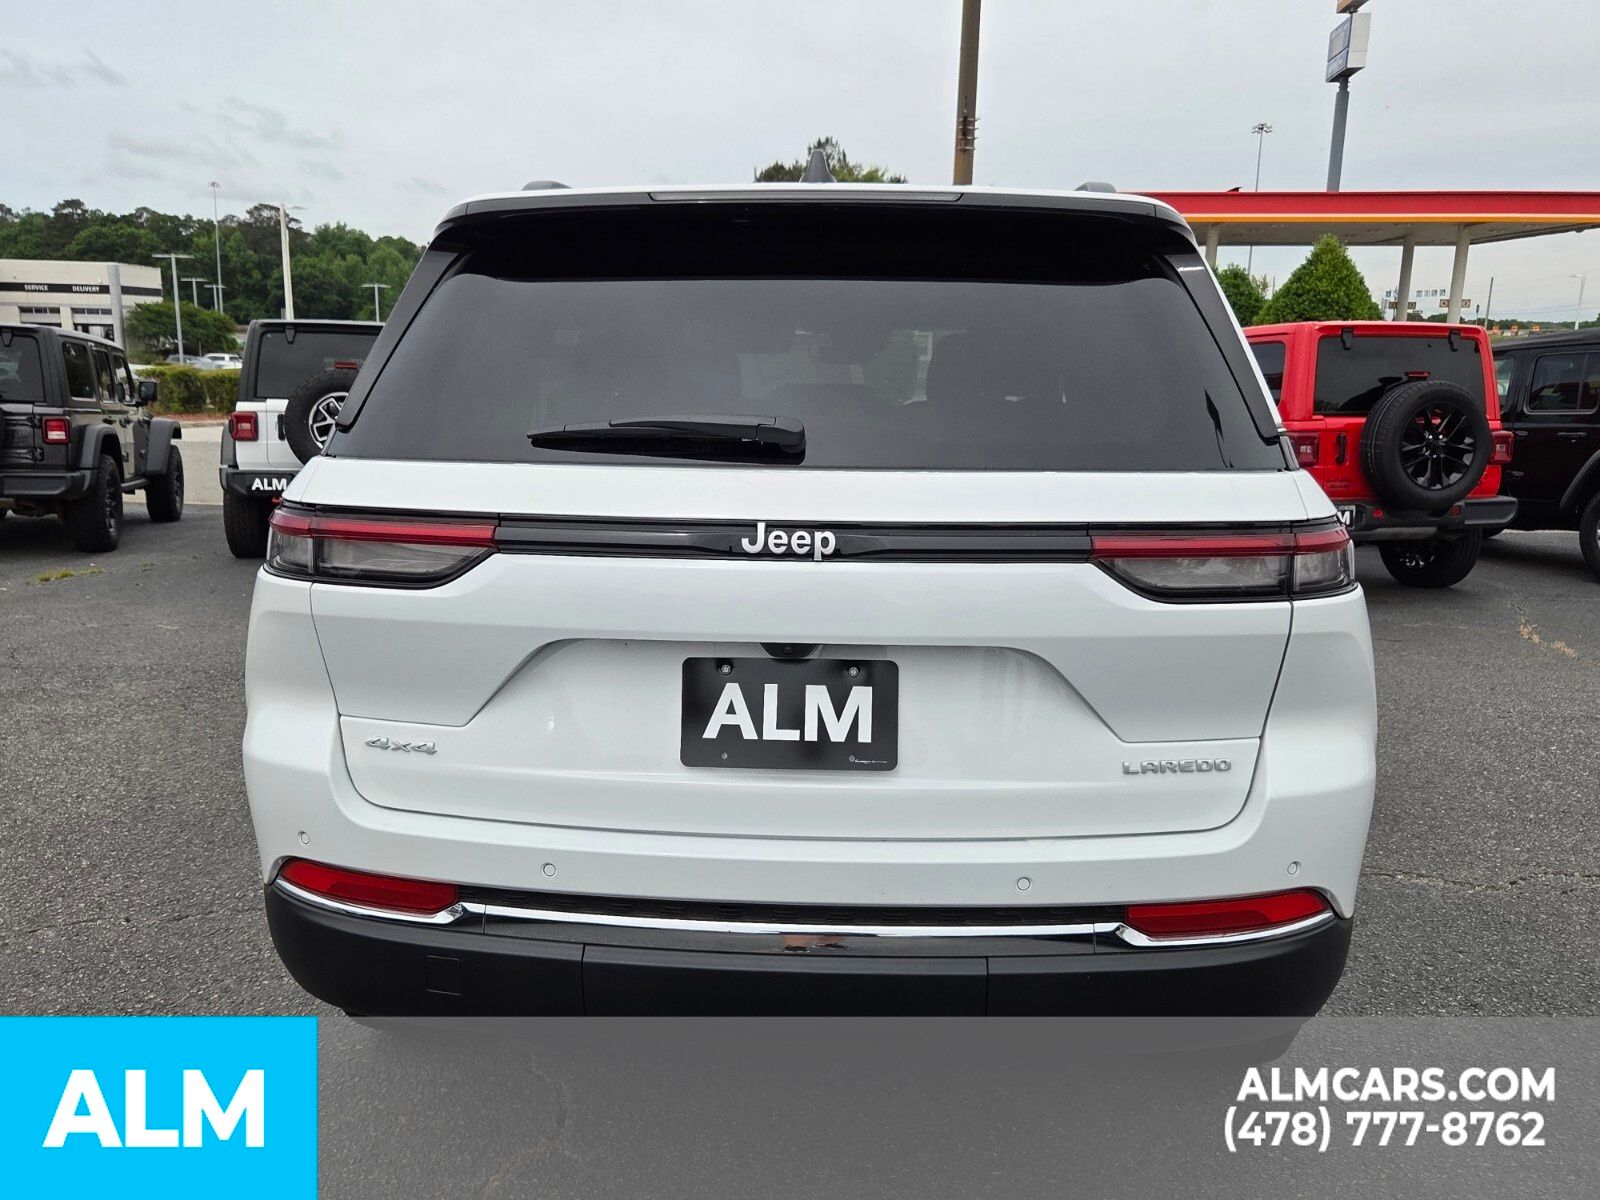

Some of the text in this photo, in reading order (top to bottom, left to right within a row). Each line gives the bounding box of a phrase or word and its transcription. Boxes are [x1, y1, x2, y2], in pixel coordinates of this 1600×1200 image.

[72, 285, 100, 293] DELIVERY
[251, 477, 288, 491] ALM
[741, 522, 836, 561] Jeep
[702, 682, 873, 743] ALM
[364, 737, 437, 755] 4x4
[1122, 759, 1232, 775] LAREDO
